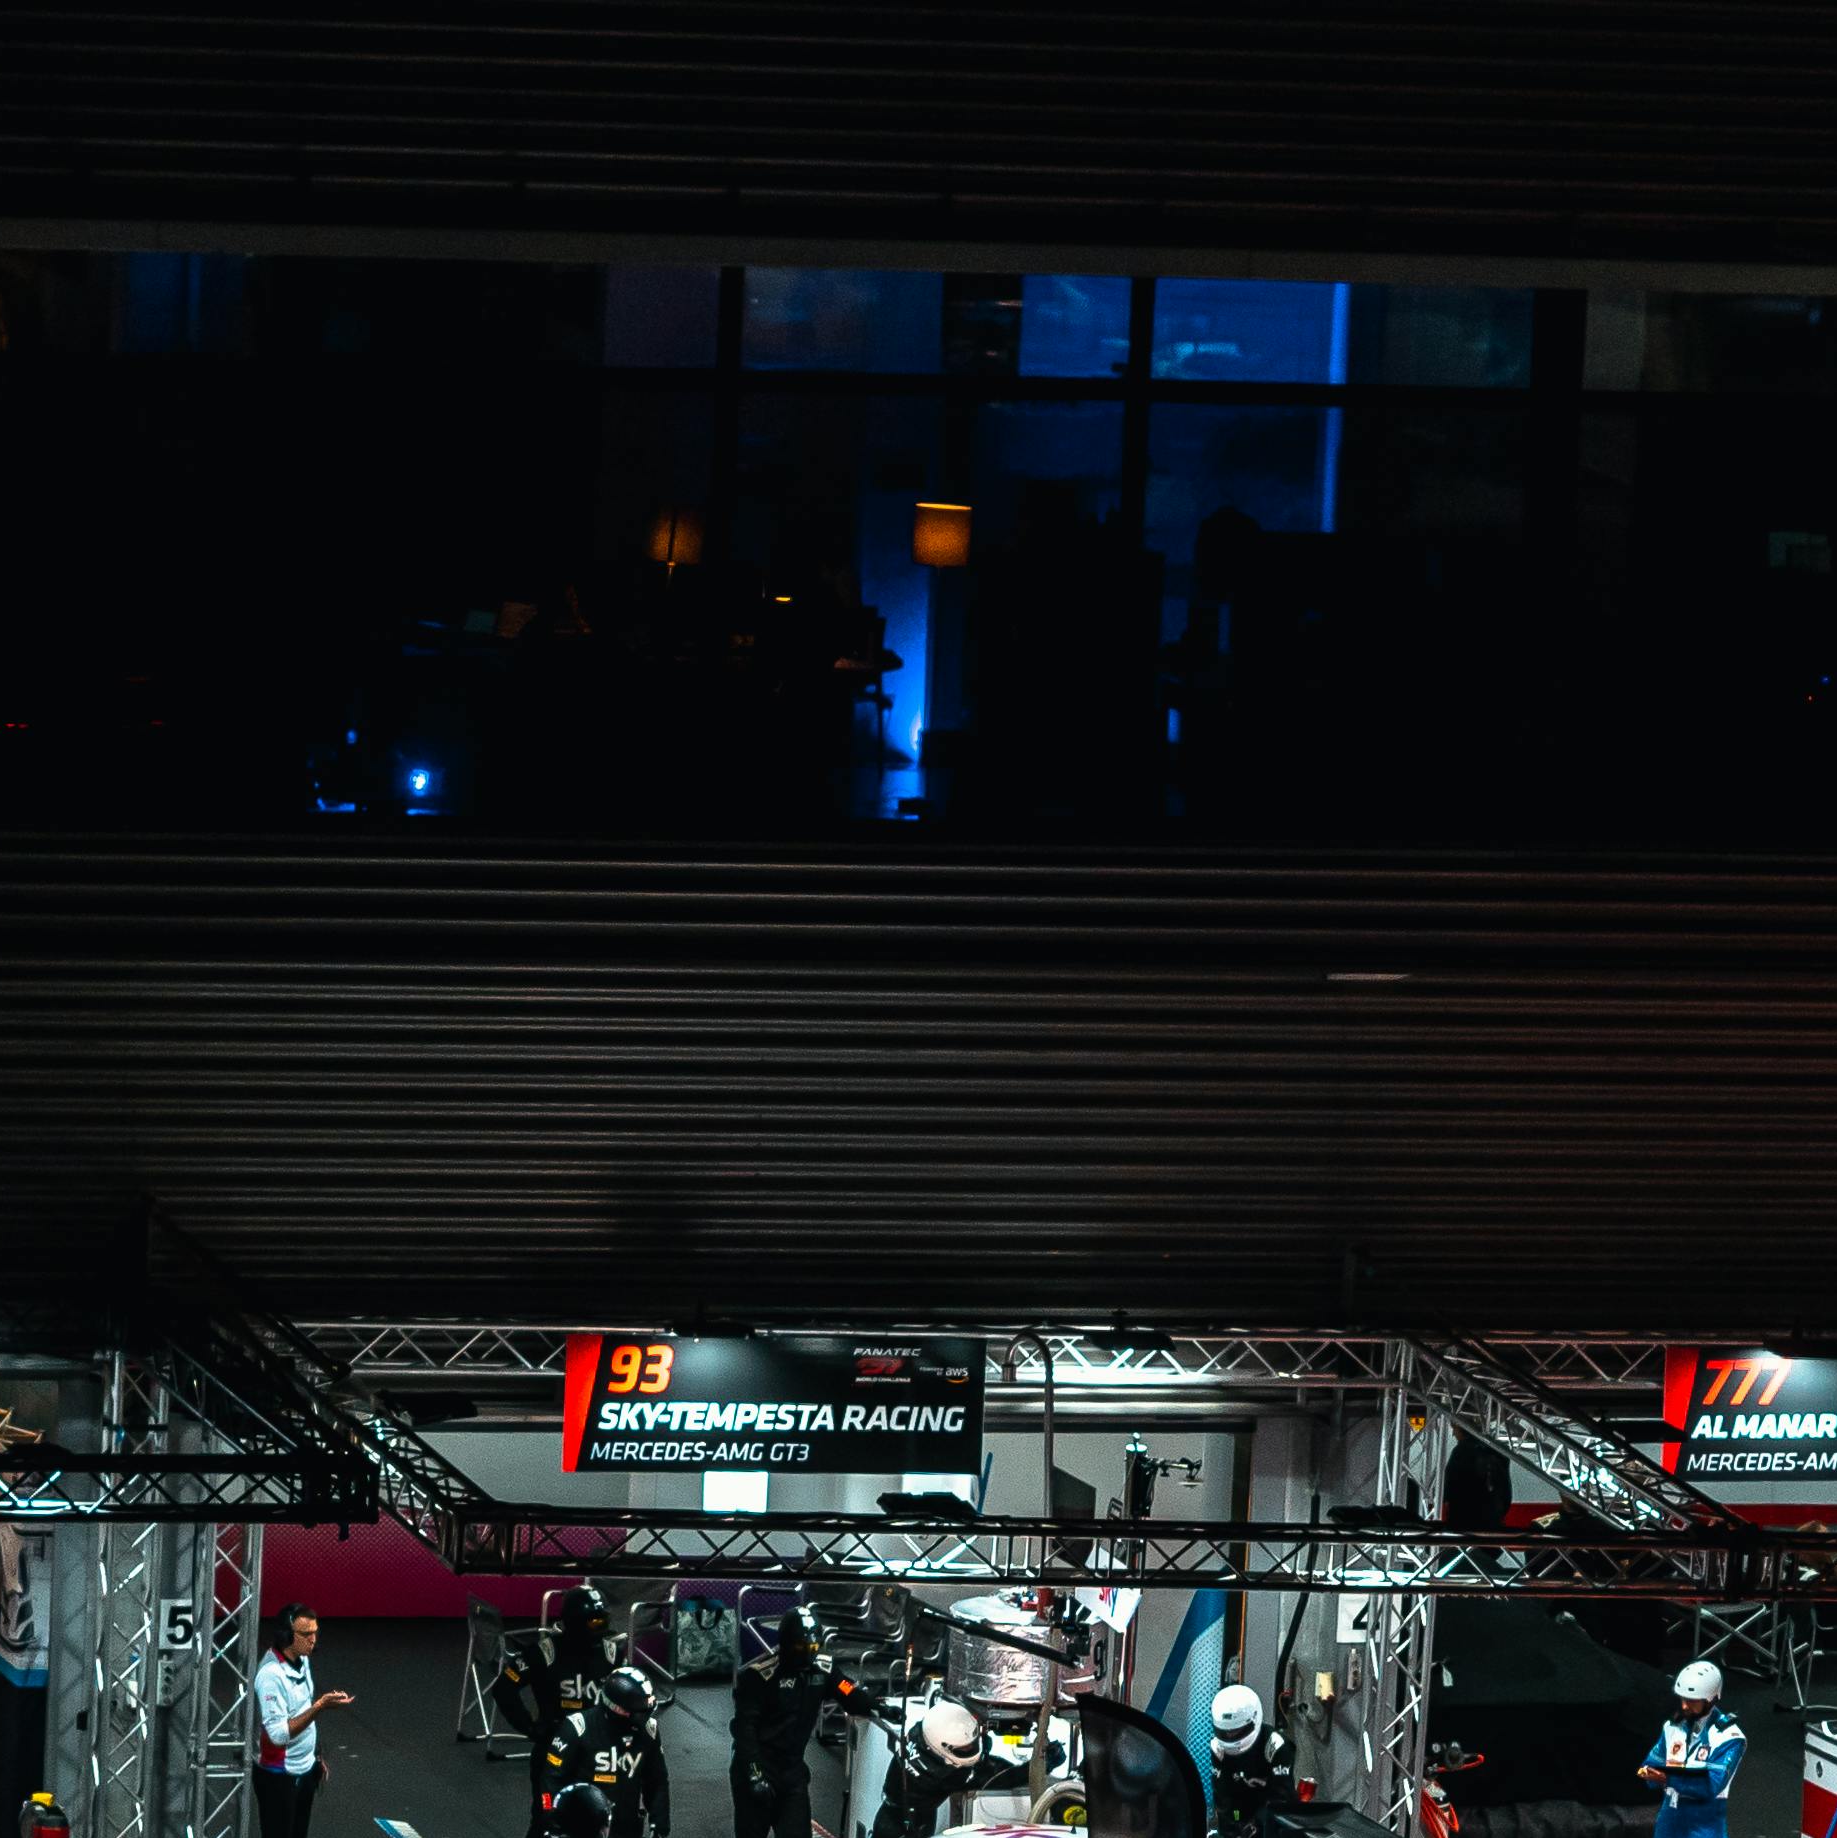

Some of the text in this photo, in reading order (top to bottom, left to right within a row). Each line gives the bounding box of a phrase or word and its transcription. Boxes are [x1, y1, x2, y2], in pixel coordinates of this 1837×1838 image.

[854, 1348, 922, 1356] FANATEC
[607, 1344, 675, 1394] 93
[945, 1367, 969, 1377] aws
[1702, 1358, 1793, 1406] 777
[598, 1402, 965, 1432] SKY-TEMPESTA RACING
[1691, 1413, 1729, 1439] AL
[590, 1441, 811, 1462] MERCEDES-AMG GT3
[167, 1606, 193, 1645] 5
[594, 1746, 642, 1779] sky
